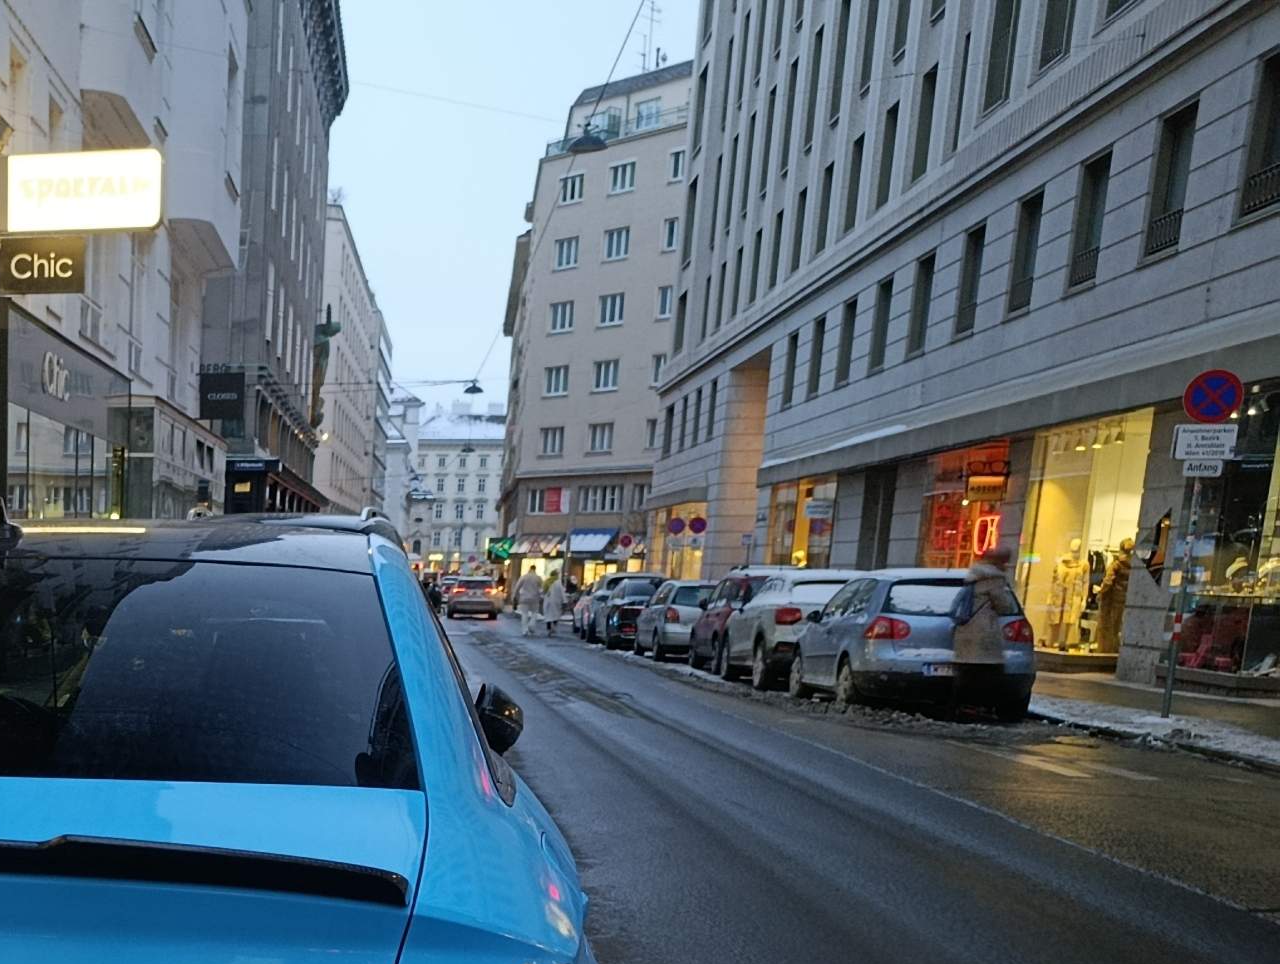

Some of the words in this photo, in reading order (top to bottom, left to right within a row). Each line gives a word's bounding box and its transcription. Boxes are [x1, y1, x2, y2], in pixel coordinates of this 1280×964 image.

[10, 252, 73, 279] Chic
[41, 350, 70, 402] Chic
[1187, 463, 1218, 473] Anfang
